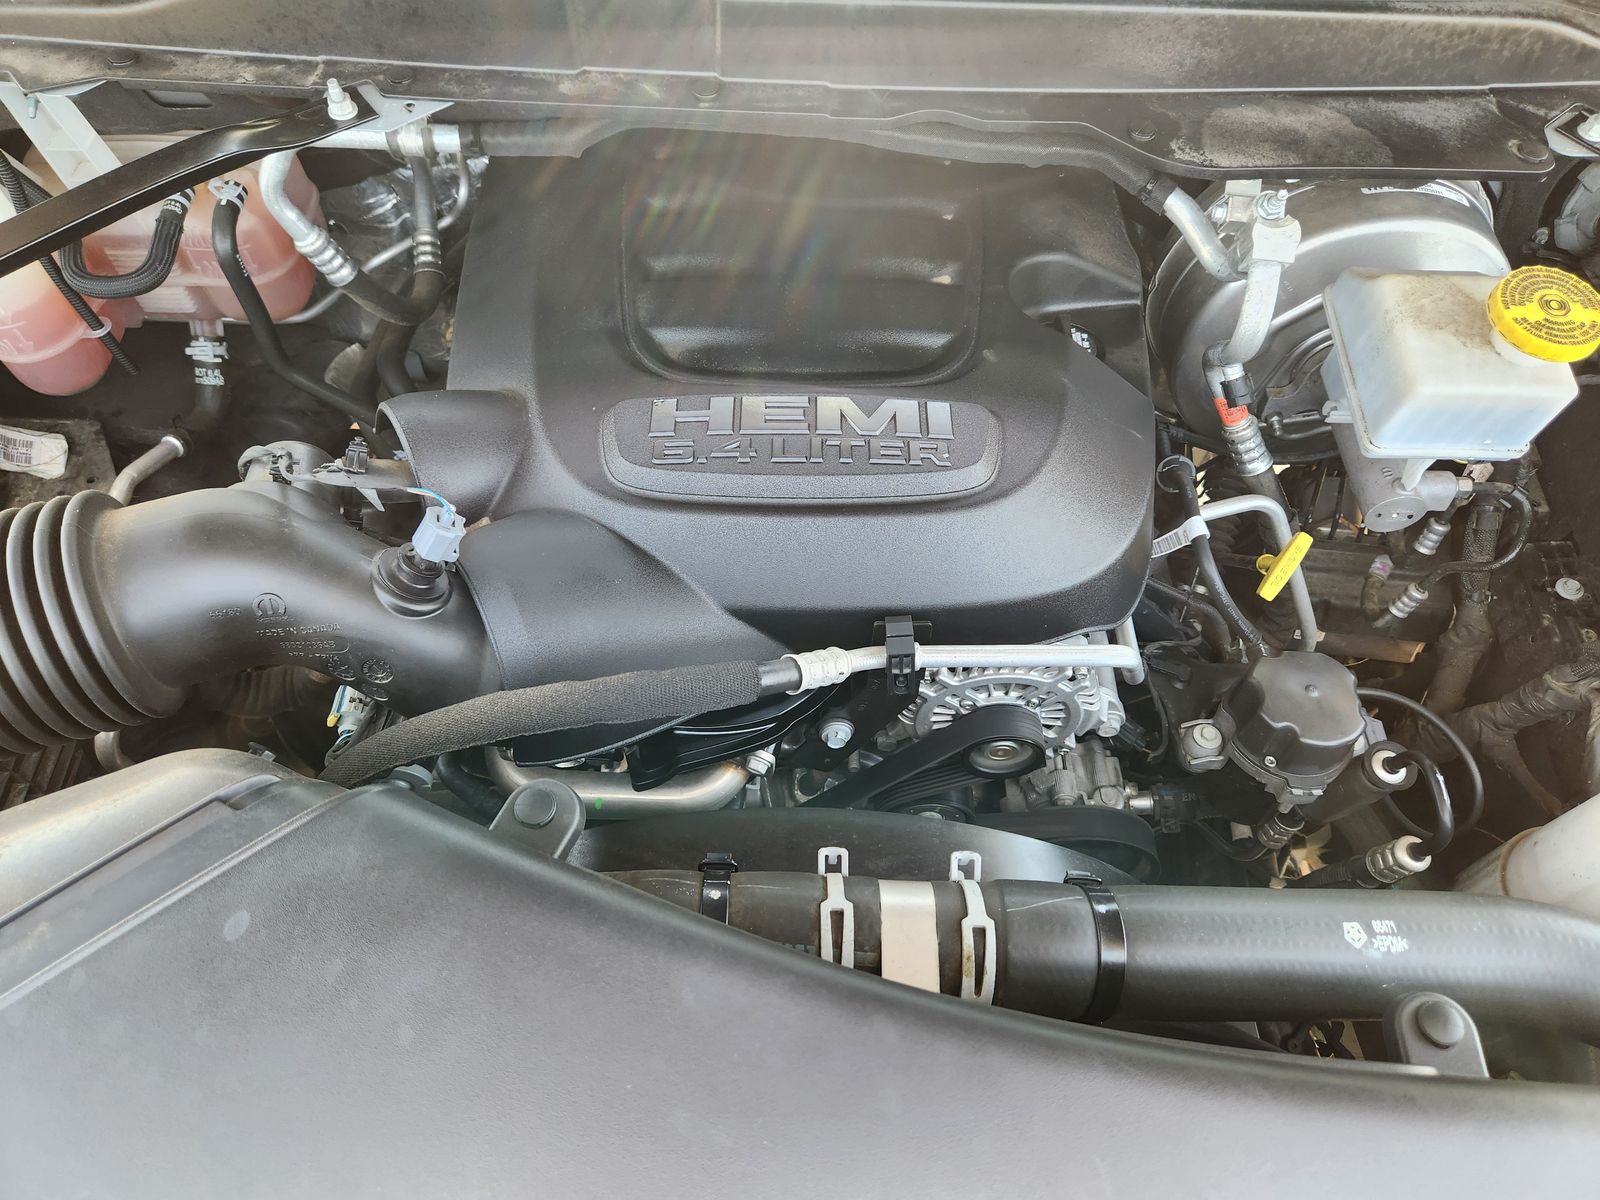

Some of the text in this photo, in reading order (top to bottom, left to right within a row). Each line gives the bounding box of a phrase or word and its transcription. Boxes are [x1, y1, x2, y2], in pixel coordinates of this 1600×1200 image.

[648, 395, 955, 440] HEMI
[651, 437, 953, 467] 6.4 LITER
[300, 622, 342, 635] CANADA
